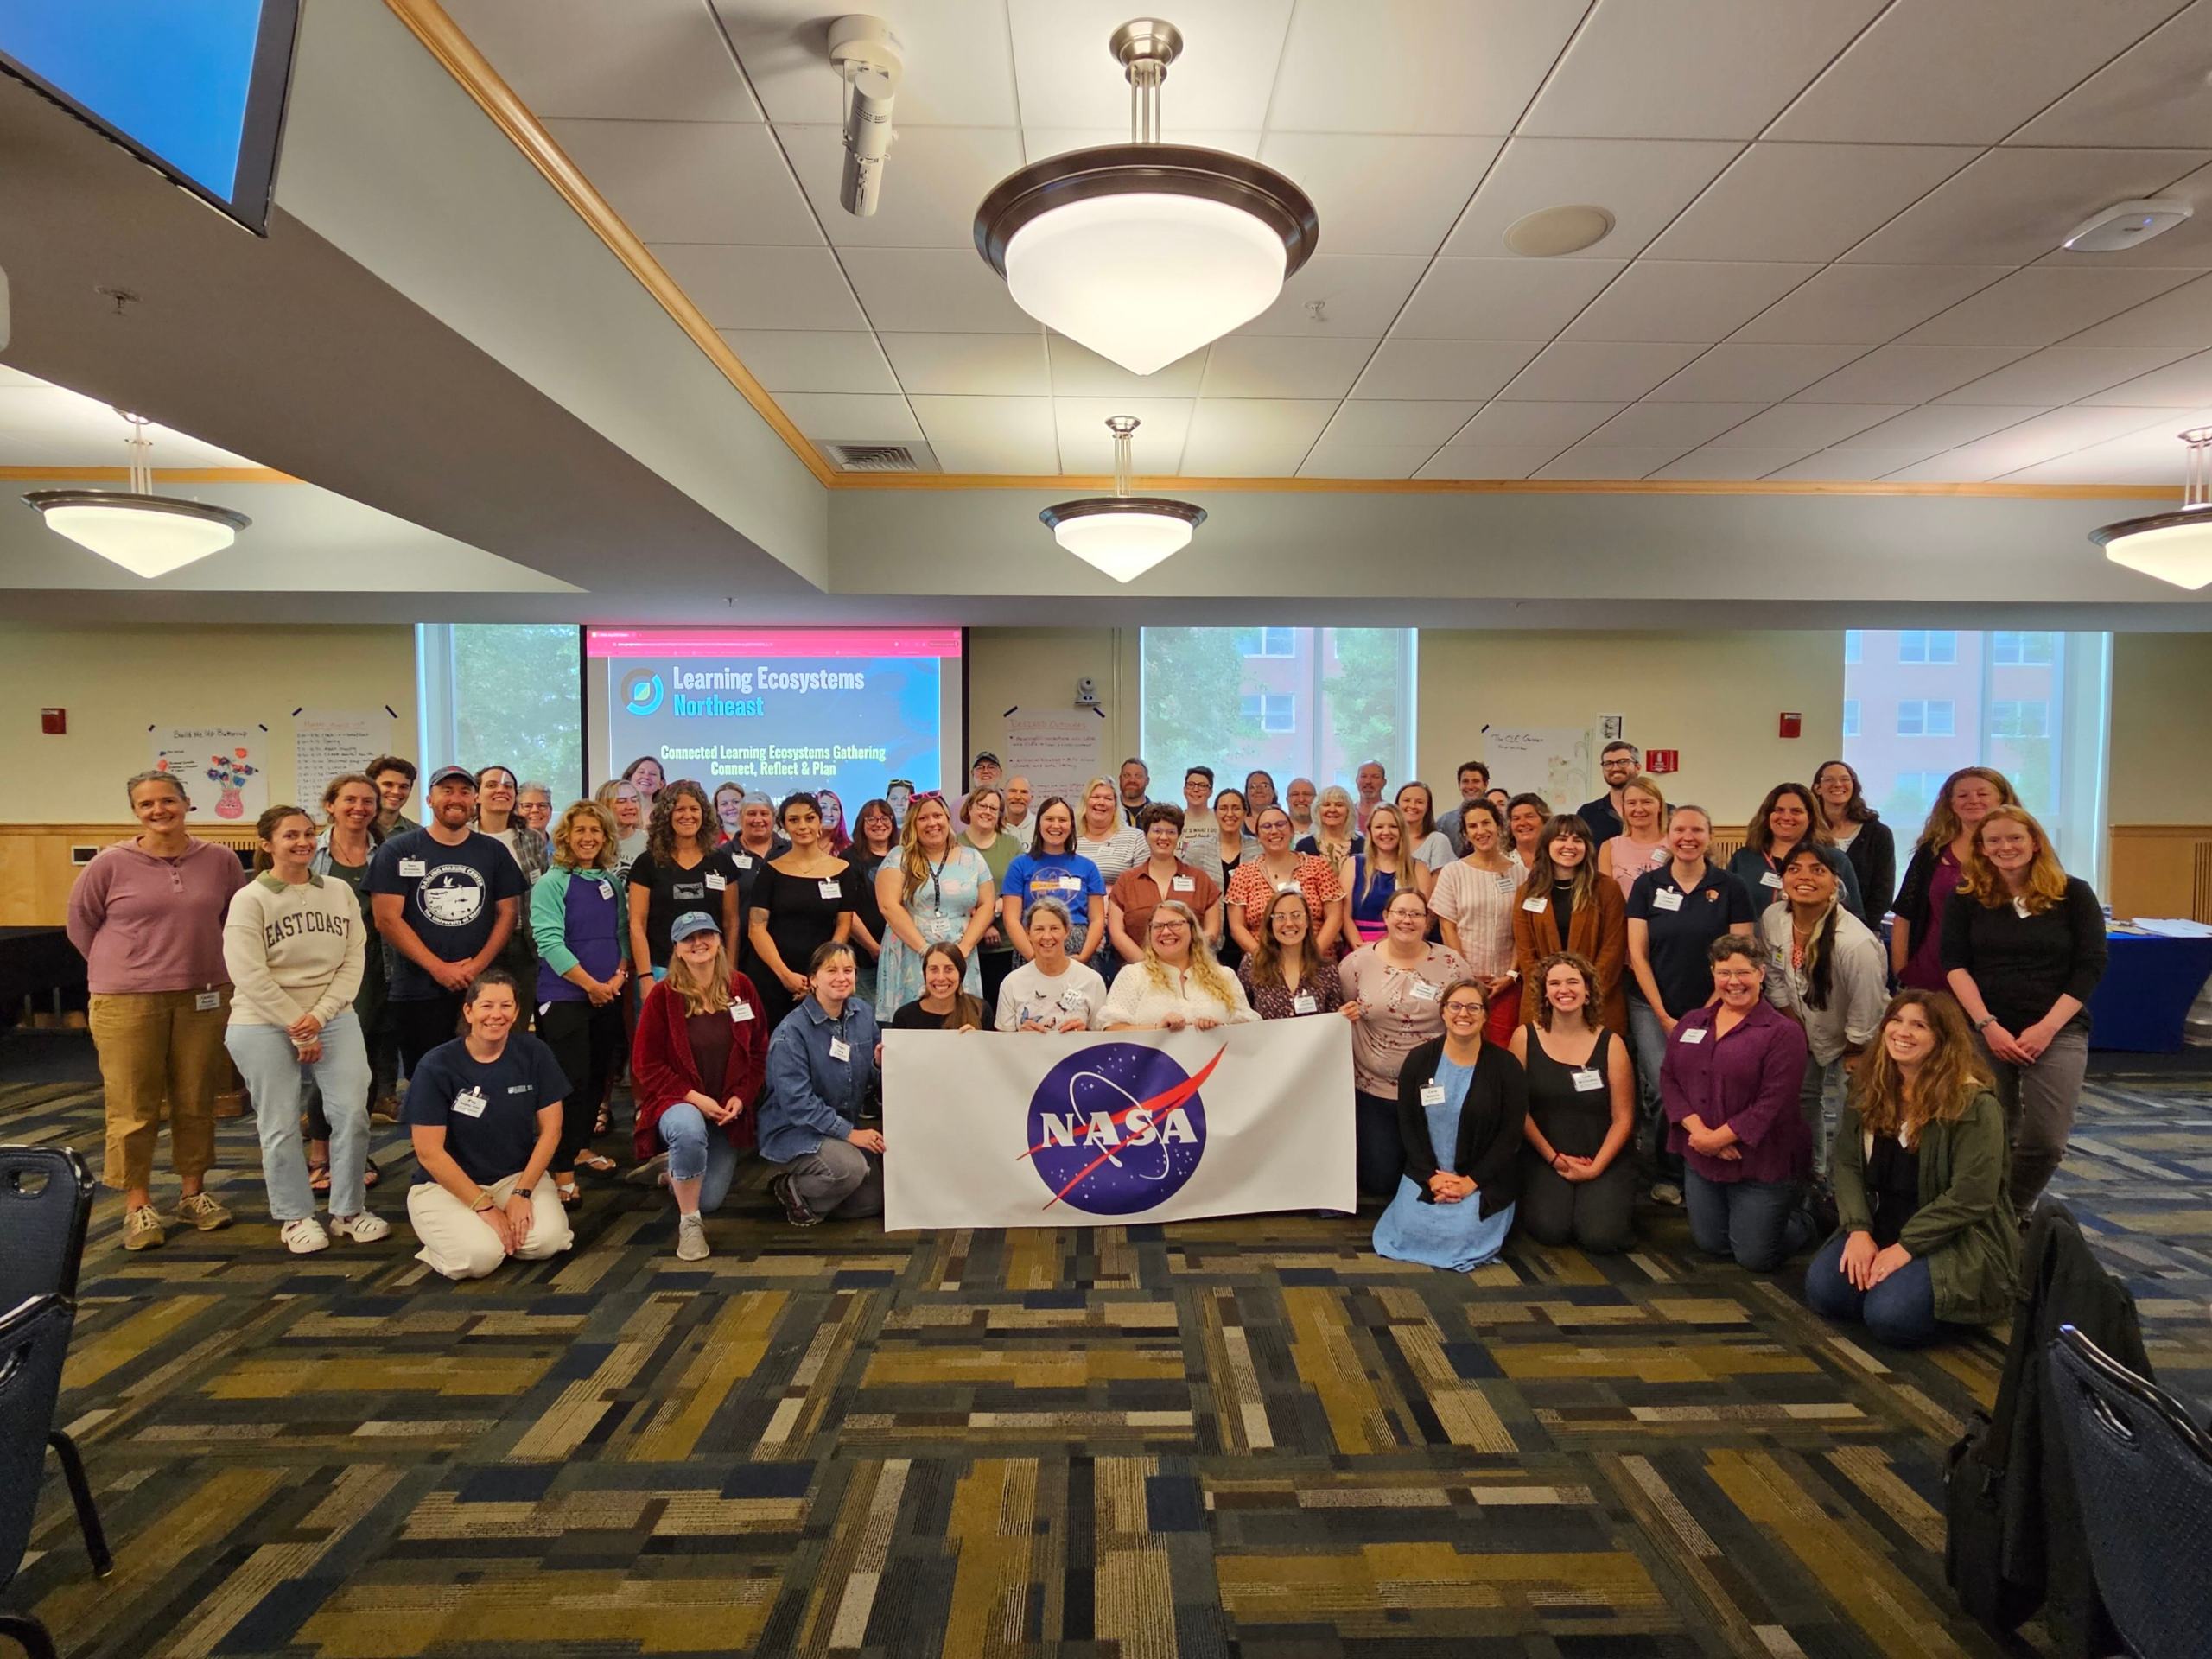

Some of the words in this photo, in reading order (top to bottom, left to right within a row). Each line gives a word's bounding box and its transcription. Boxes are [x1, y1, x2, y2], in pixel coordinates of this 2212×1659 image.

[673, 666, 753, 694] Learning
[757, 666, 865, 694] Ecosystems
[673, 694, 765, 717] Northeast
[660, 744, 719, 760] Connected
[720, 744, 766, 762] Learning
[767, 745, 830, 761] Ecosystems
[833, 745, 887, 762] Gathering
[710, 761, 758, 778] Connect,
[760, 761, 799, 776] Reflect
[801, 762, 810, 776] &
[812, 762, 836, 776] Plan
[420, 868, 442, 890] DARLING
[467, 868, 484, 887] CENTER
[265, 912, 303, 949] EAST
[306, 912, 350, 940] COAST
[1040, 1108, 1199, 1148] NASA
